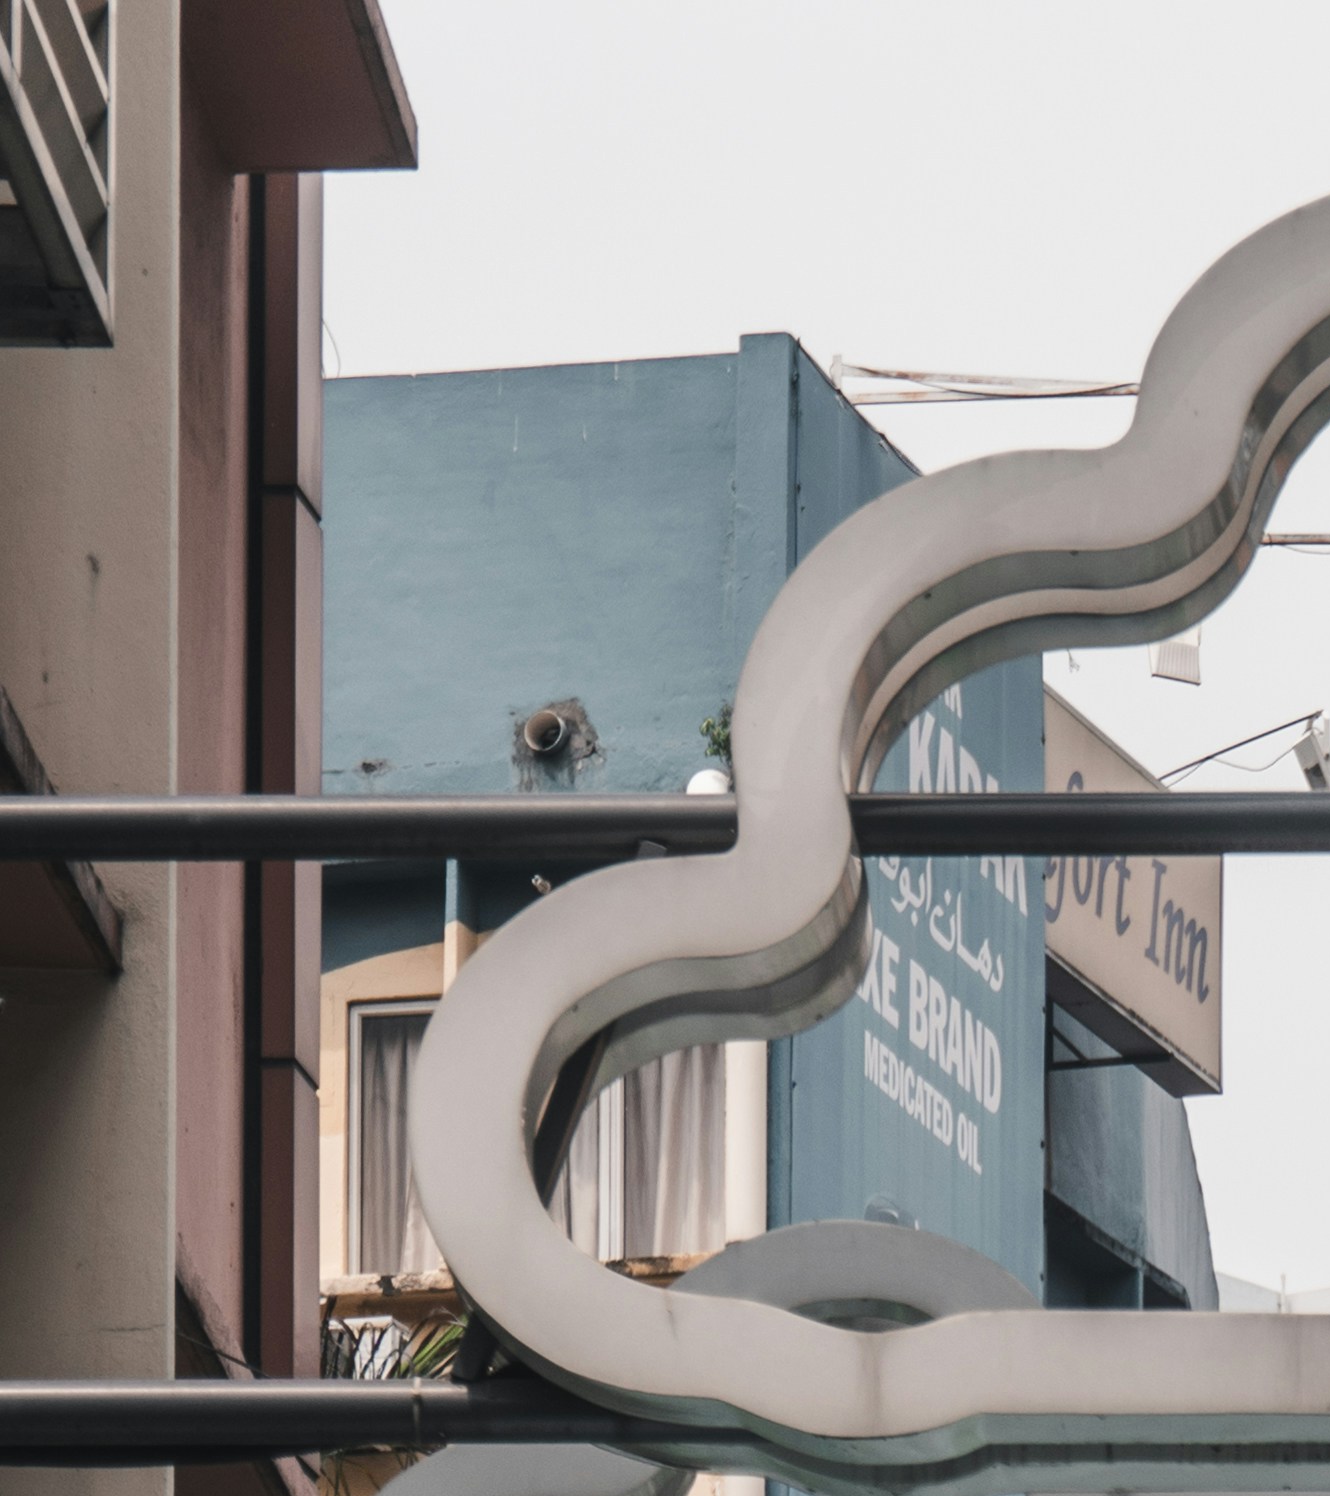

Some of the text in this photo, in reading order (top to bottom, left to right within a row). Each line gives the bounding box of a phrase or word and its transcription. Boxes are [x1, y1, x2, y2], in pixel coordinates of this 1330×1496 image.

[1144, 858, 1209, 1004] Inn
[856, 928, 1001, 1115] XE BRAND
[864, 1029, 982, 1176] MEDICATED OIL
